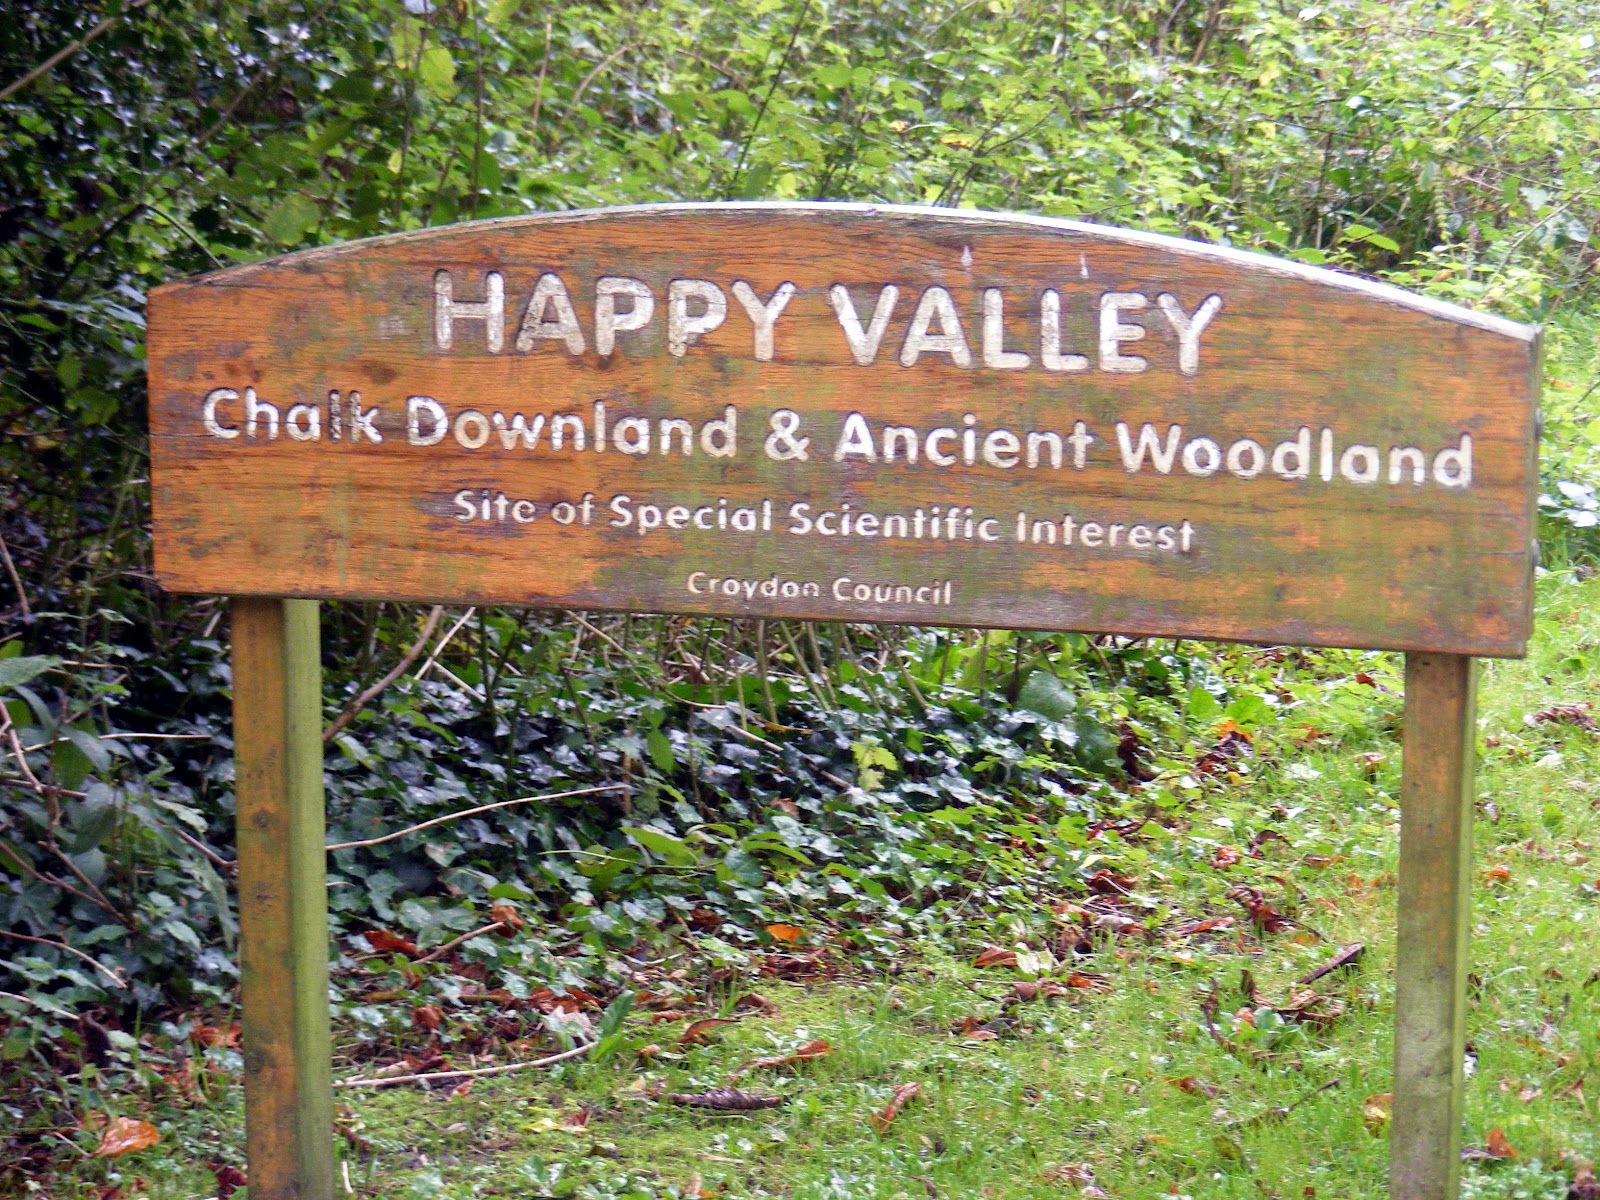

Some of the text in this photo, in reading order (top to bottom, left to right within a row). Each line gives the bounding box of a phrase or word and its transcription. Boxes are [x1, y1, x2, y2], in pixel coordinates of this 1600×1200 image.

[434, 268, 1223, 376] HAPPY VALLEY
[201, 386, 1474, 490] Chalk Downland & Ancient Woodland
[453, 488, 1196, 553] Site of Special Scientific Interest
[687, 570, 953, 606] Croydon Council
